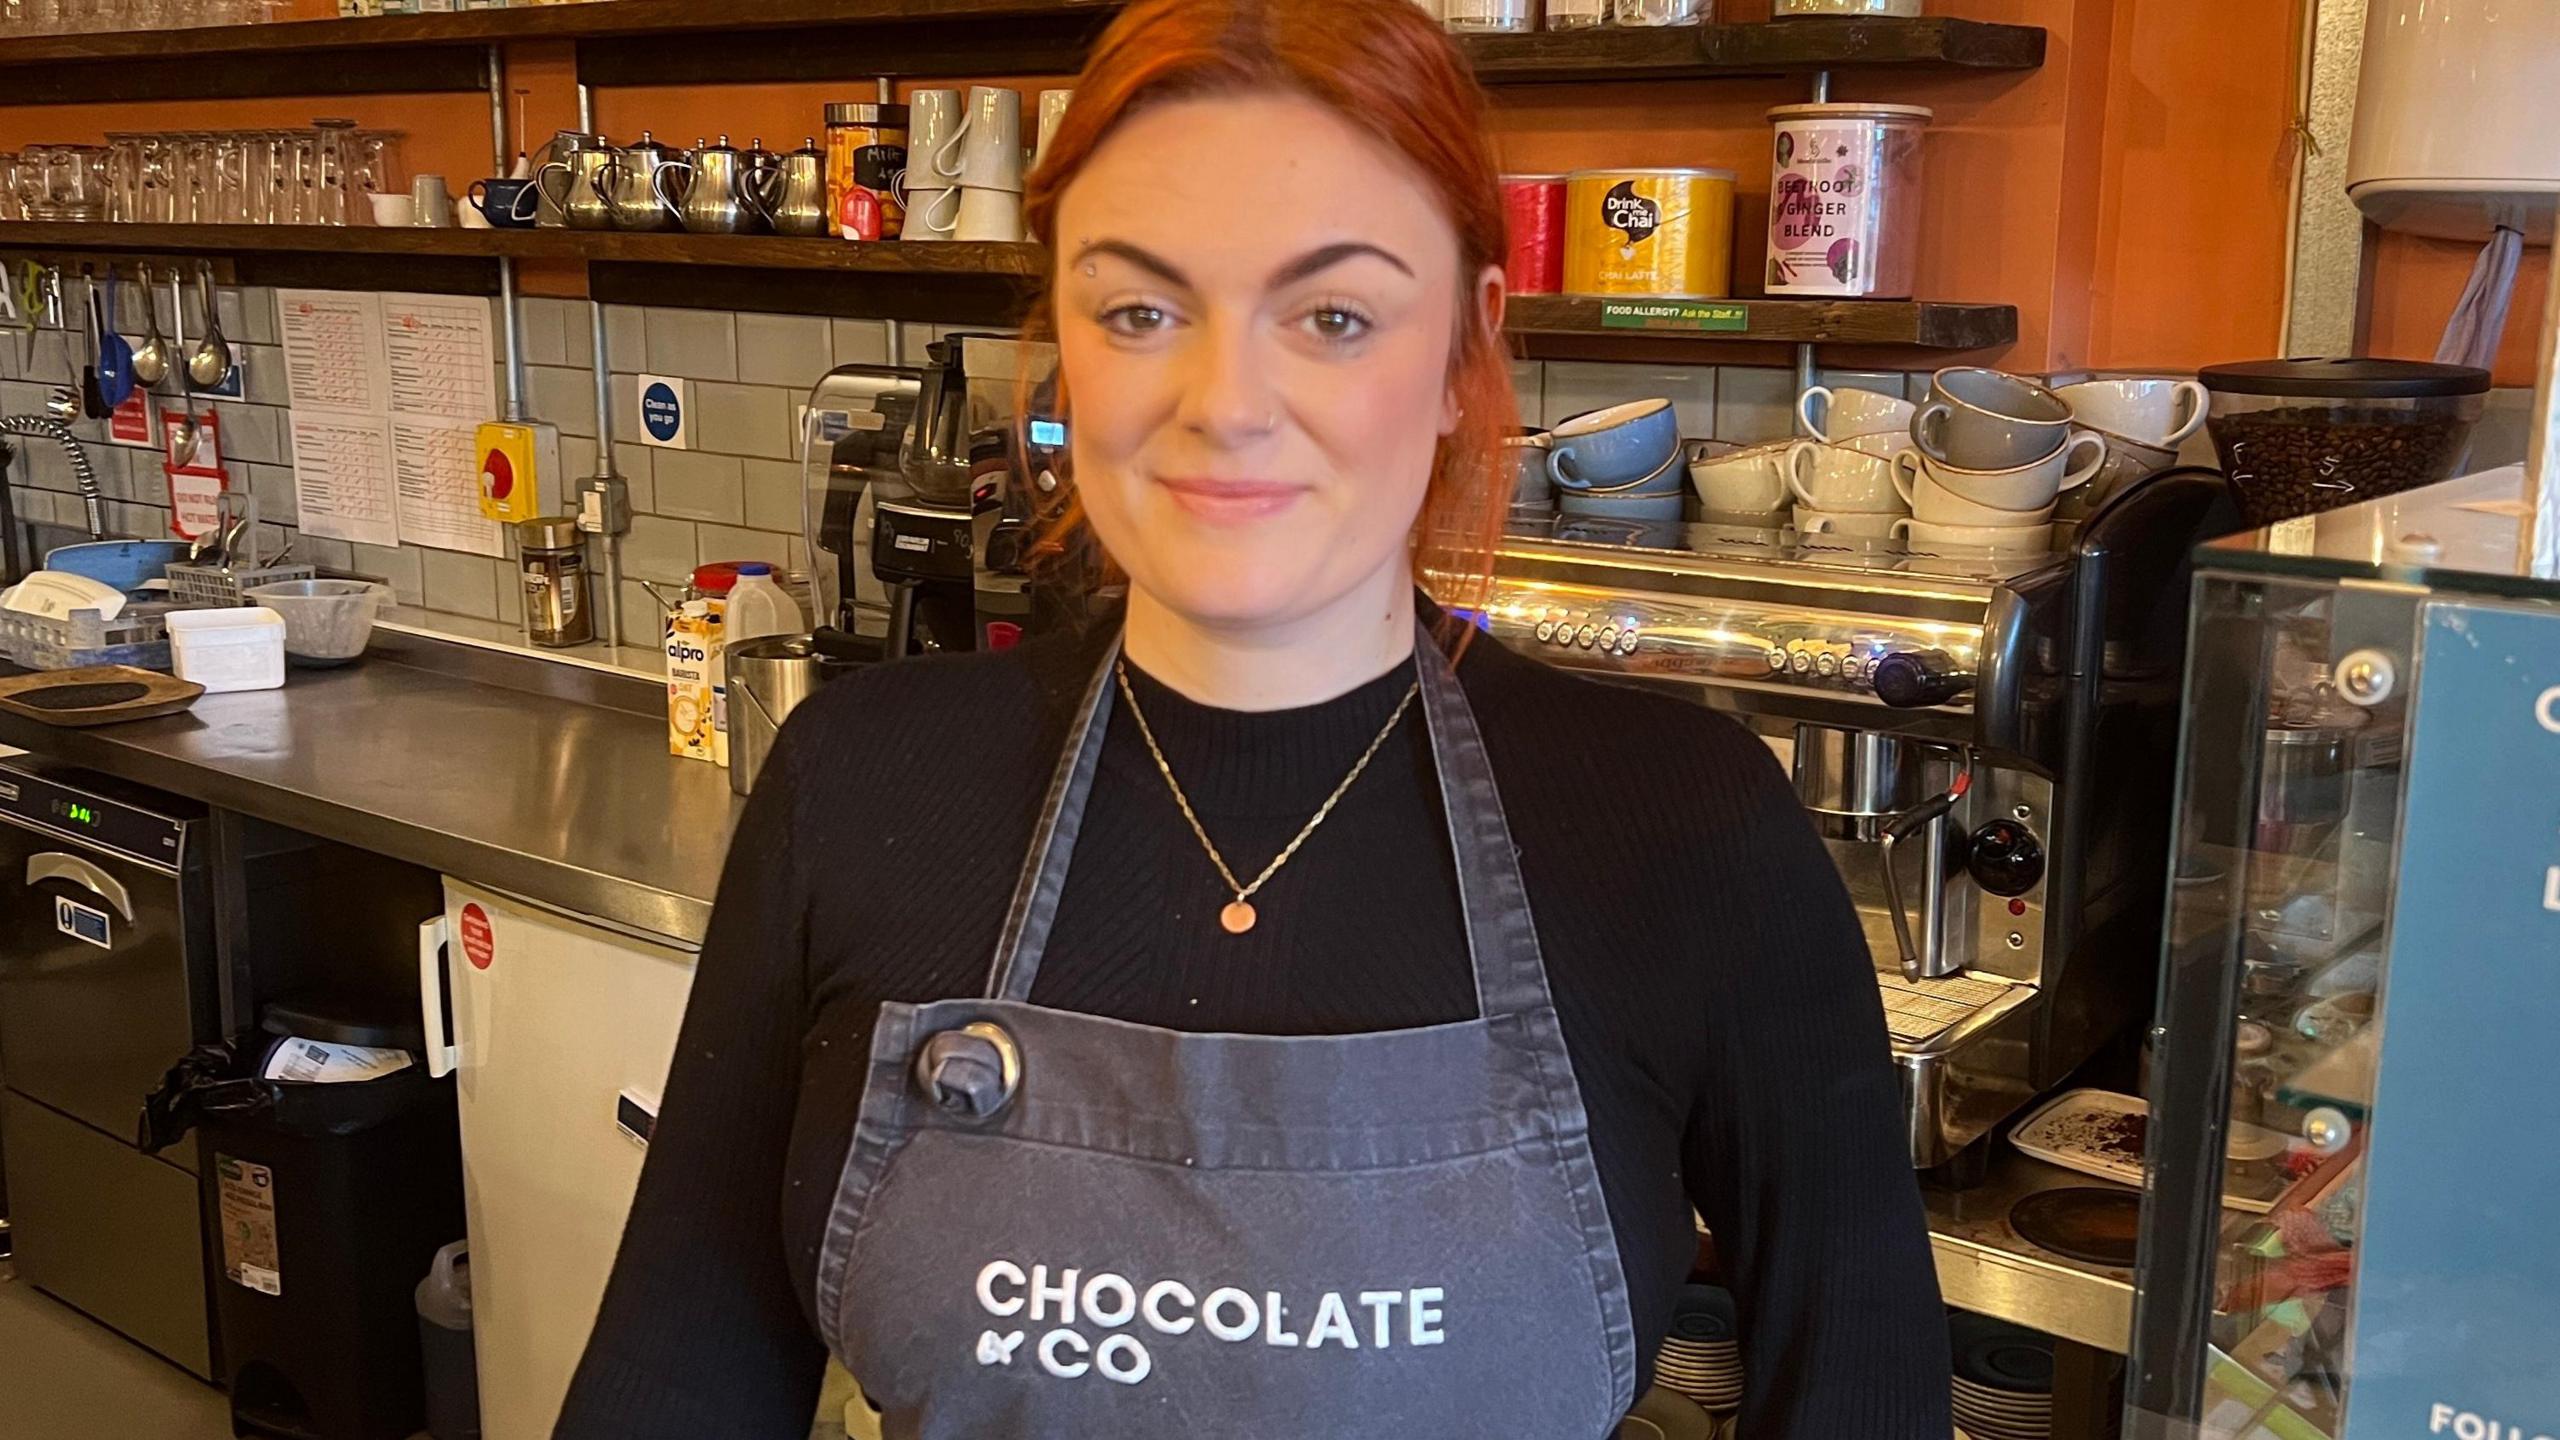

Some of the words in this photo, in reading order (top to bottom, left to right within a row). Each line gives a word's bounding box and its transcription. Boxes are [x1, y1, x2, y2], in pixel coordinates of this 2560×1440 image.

[1777, 180, 1853, 194] BEETROOT
[1607, 197, 1644, 210] Drink
[1786, 202, 1847, 215] GINGER
[1613, 211, 1654, 228] Chai
[1784, 224, 1835, 237] BLEND
[1606, 305, 1633, 316] FOOD
[1633, 306, 1680, 317] ALLERGY?
[1681, 308, 1697, 318] Ask
[1697, 309, 1711, 319] the
[645, 398, 667, 410] Clean
[667, 402, 676, 411] as
[649, 413, 663, 423] you
[664, 414, 674, 425] go
[668, 641, 704, 663] alpro
[975, 1259, 1445, 1349] CHOCOLATE
[1038, 1327, 1152, 1385] CO
